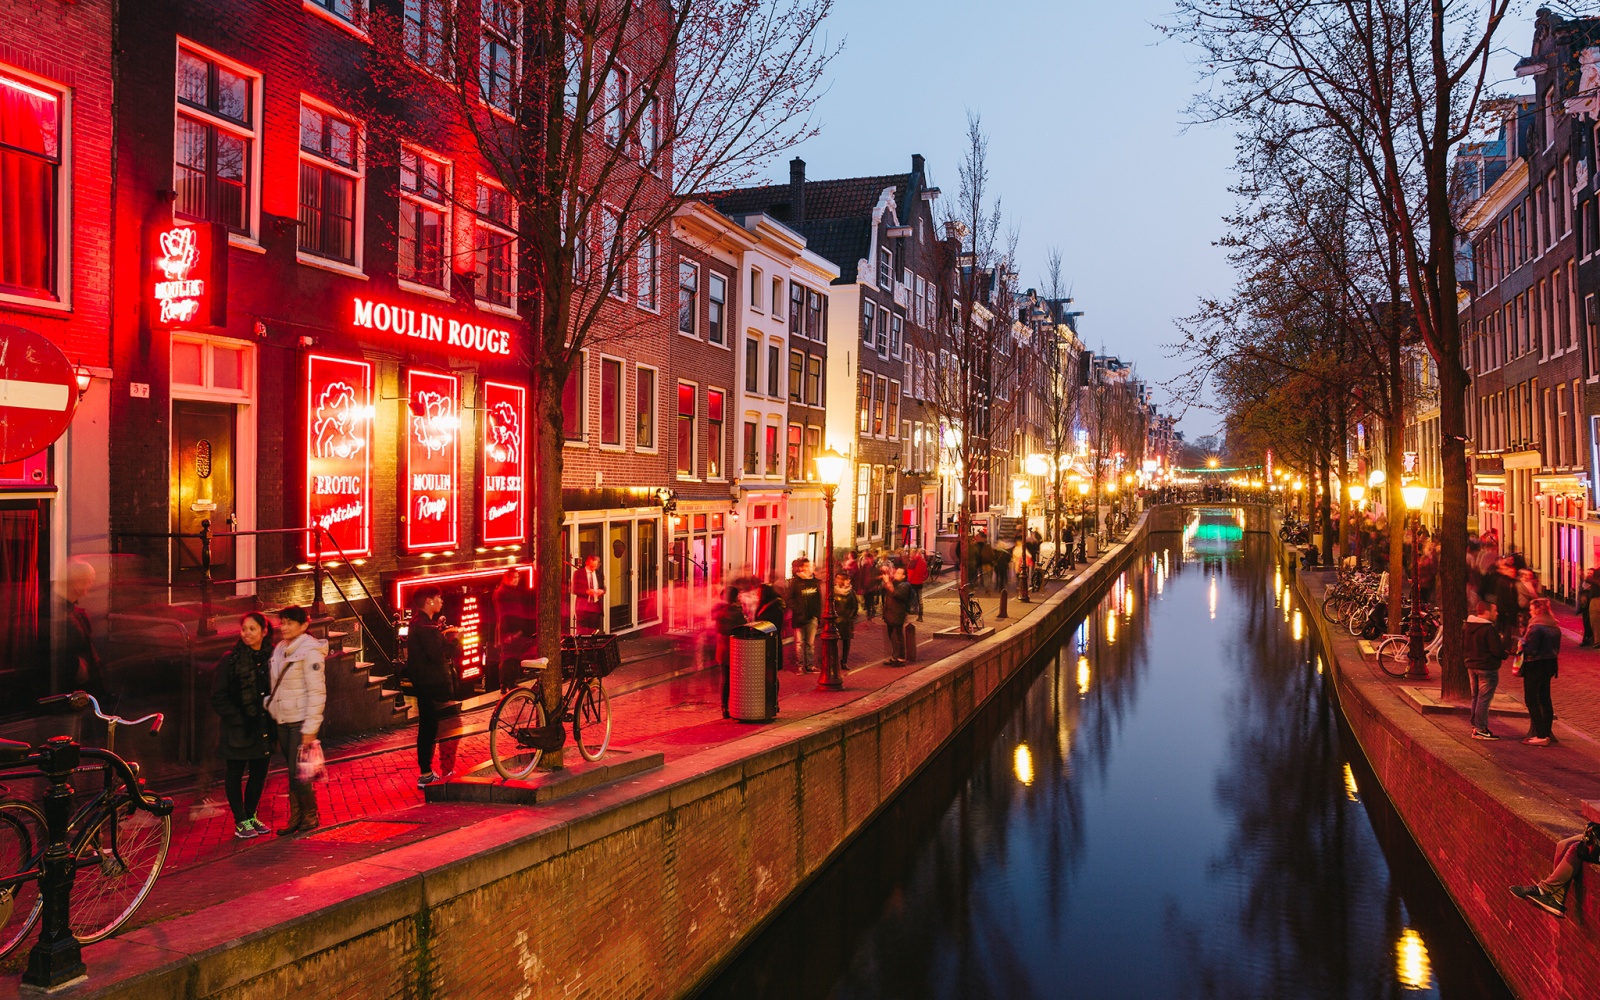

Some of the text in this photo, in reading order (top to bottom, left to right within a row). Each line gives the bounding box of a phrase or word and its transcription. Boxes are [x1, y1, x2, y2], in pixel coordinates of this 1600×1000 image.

[155, 280, 204, 299] MOULIN
[353, 298, 510, 355] MOULIN ROUGE
[316, 475, 360, 495] EROTIC
[413, 473, 451, 491] MOULIN
[486, 475, 522, 492] LIVE SEX
[311, 500, 363, 530] ightclub
